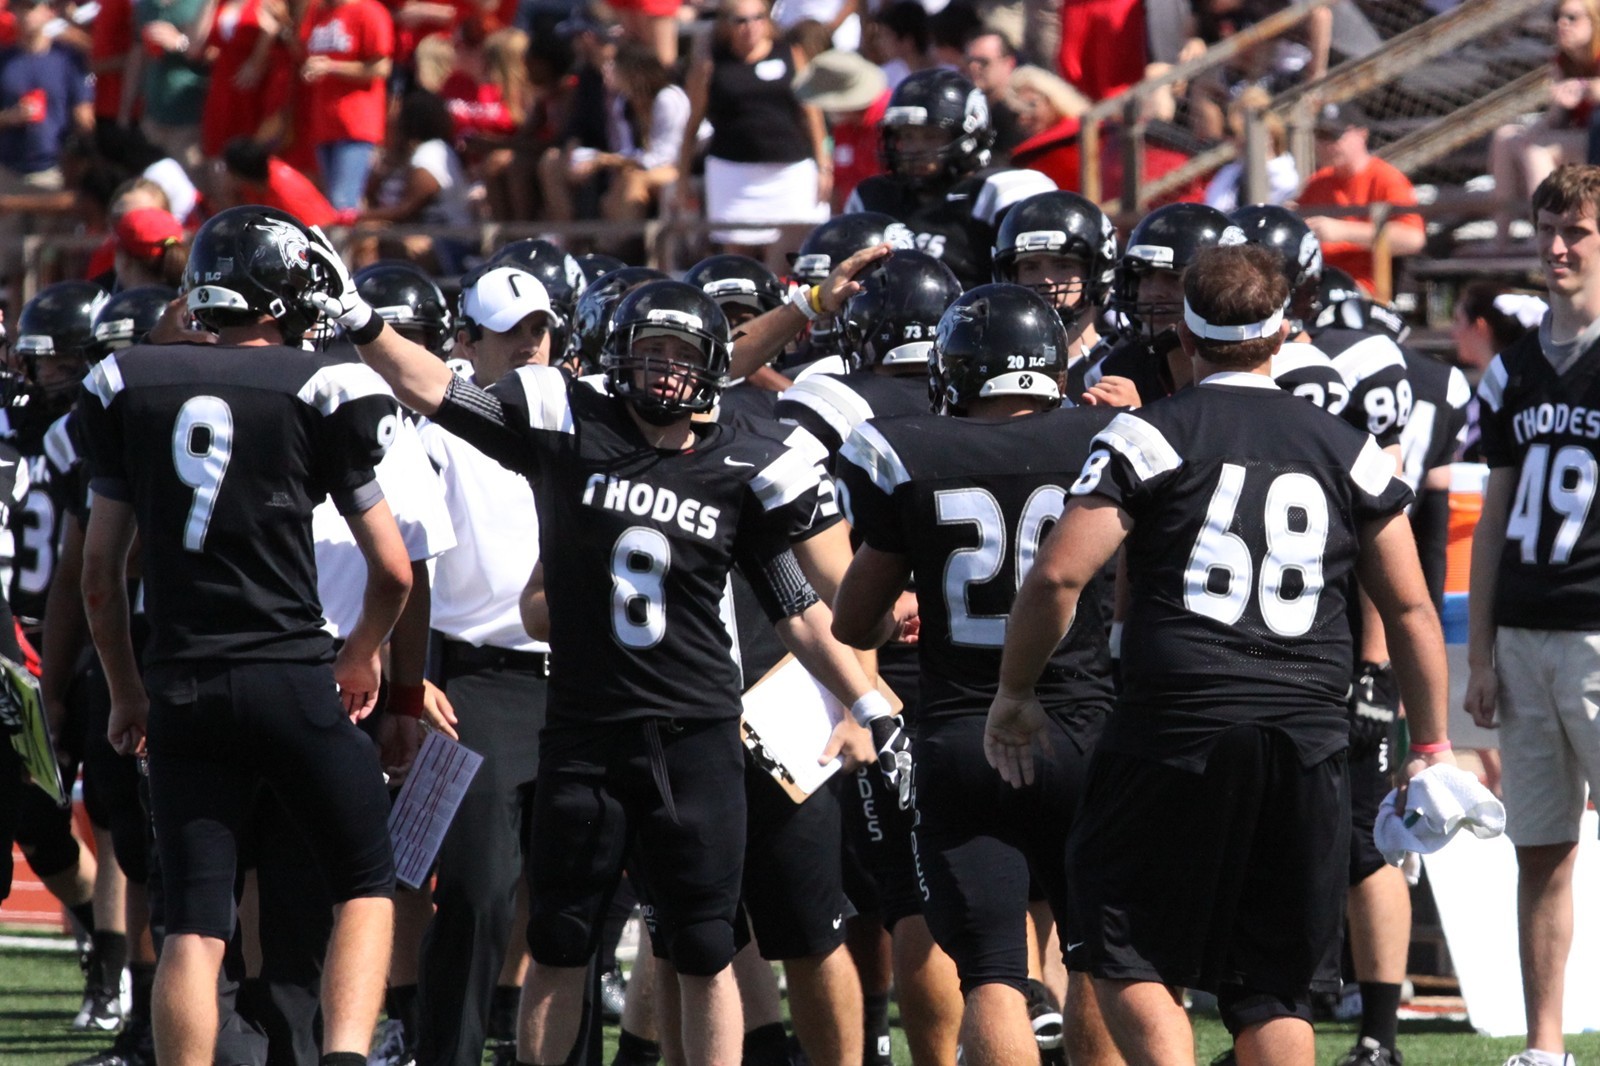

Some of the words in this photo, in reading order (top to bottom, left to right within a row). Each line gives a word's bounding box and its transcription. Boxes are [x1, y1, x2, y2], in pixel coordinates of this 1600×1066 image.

[904, 325, 922, 339] 73
[1007, 355, 1025, 369] 20
[172, 394, 234, 554] 9
[1506, 443, 1599, 565] 49
[610, 525, 671, 650] 8
[933, 484, 1069, 647] 20
[1183, 462, 1330, 638] 68
